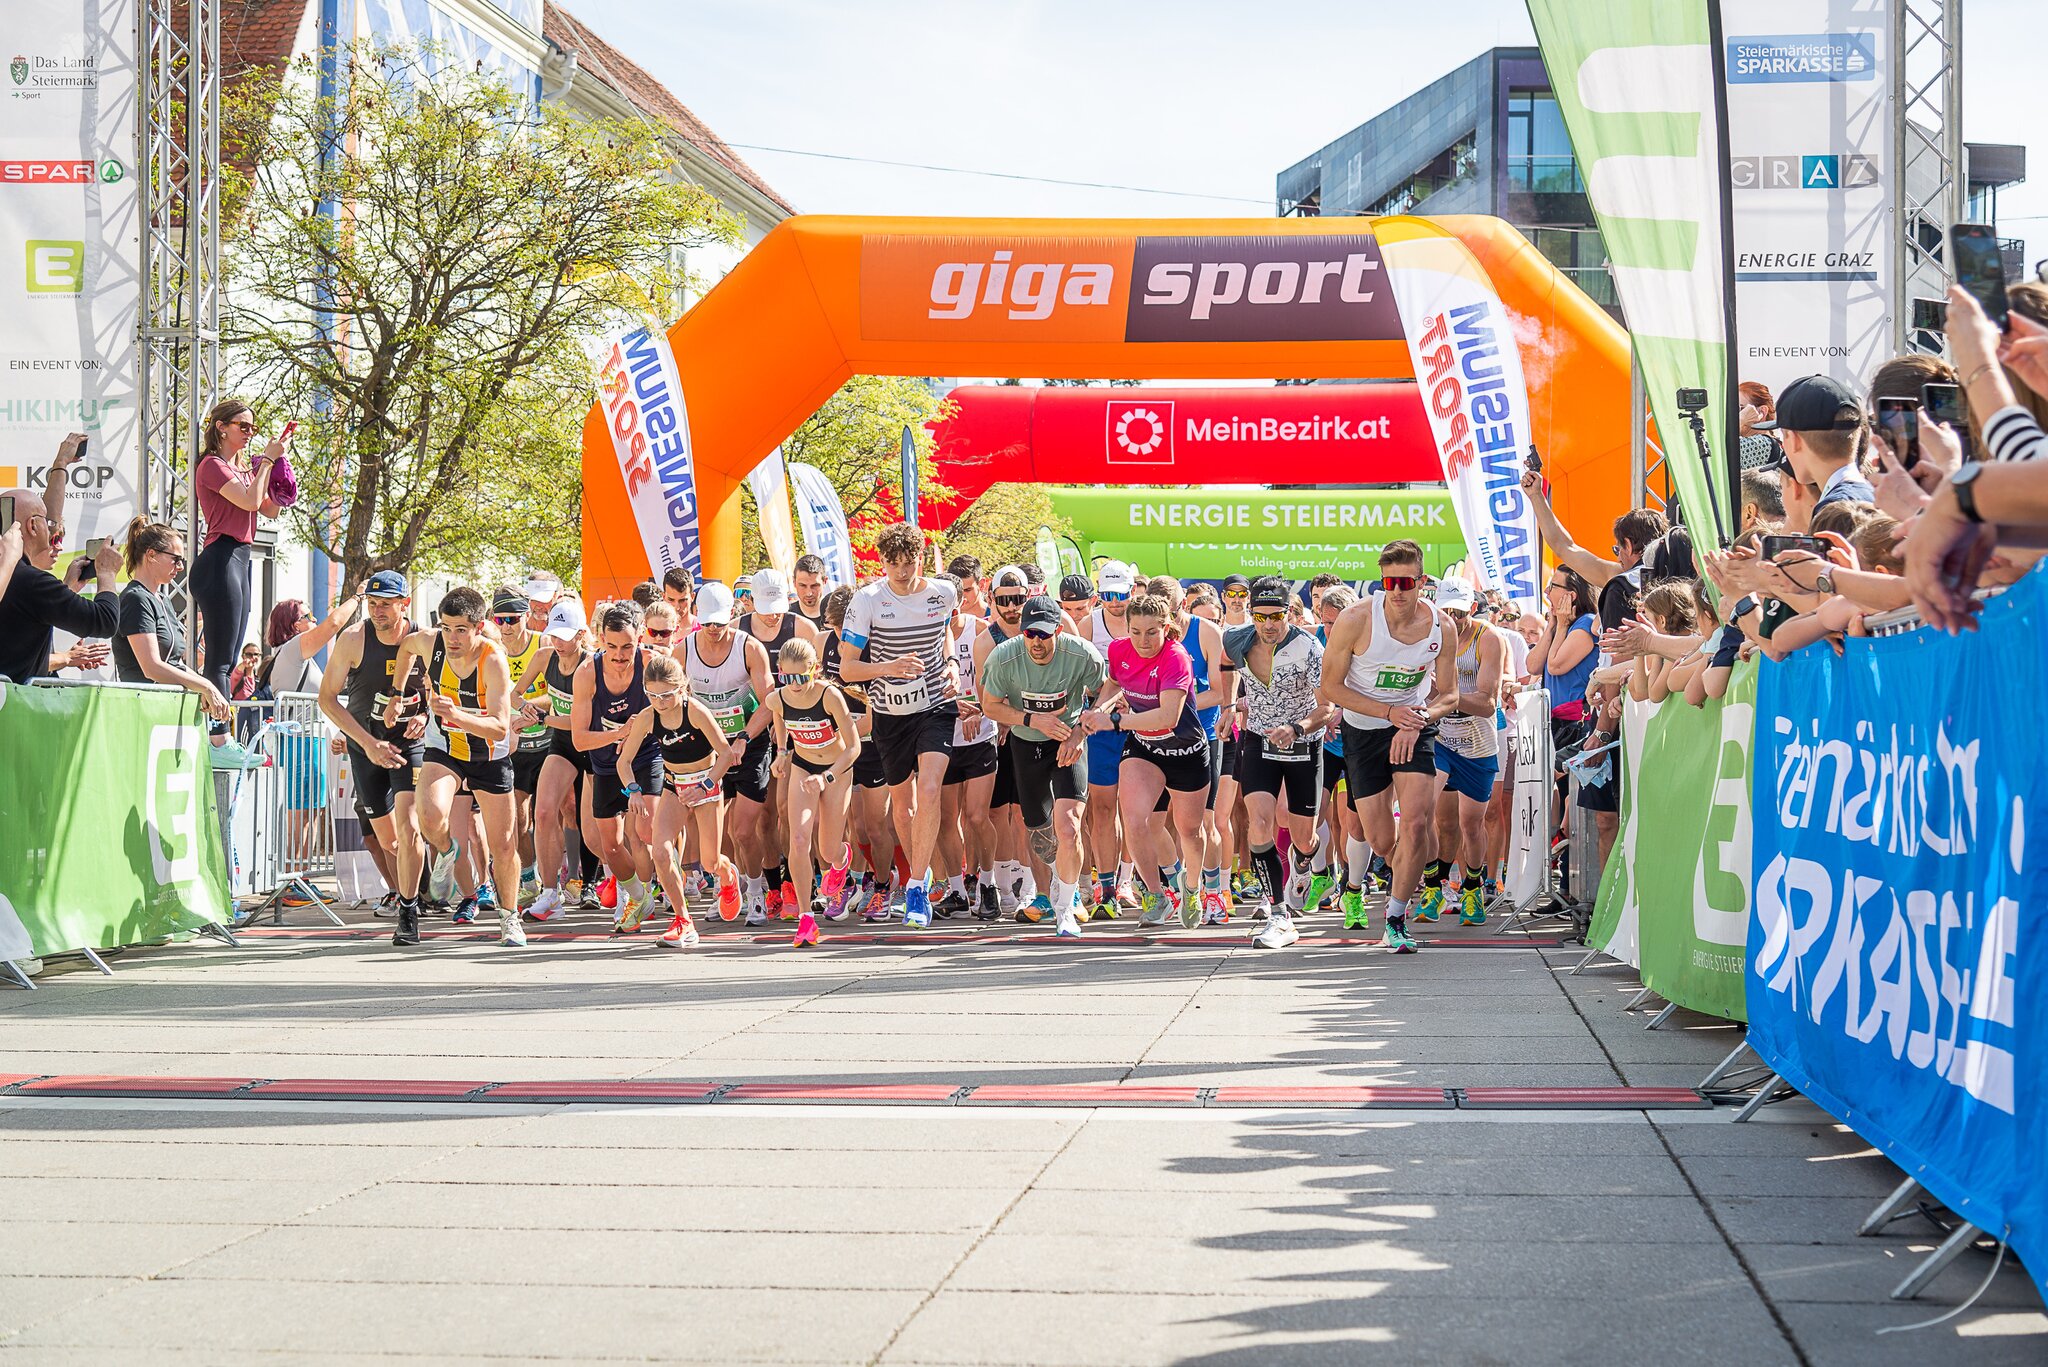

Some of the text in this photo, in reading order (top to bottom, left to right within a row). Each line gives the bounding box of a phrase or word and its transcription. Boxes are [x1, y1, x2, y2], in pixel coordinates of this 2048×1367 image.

[1737, 44, 1843, 58] Steiermärkische
[35, 56, 94, 68] Das Land
[1737, 56, 1843, 75] SPARKASSE
[32, 74, 95, 86] Steiermark
[21, 92, 41, 100] Sport
[4, 164, 93, 180] SPAR
[1731, 158, 1874, 187] GRAZ
[1739, 253, 1875, 268] ENERGIE GRAZ
[928, 250, 1379, 320] giga sport
[1750, 347, 1770, 357] EIN
[1774, 347, 1815, 357] EVENT
[10, 360, 30, 370] EIN
[33, 360, 71, 370] EVENT
[1186, 415, 1390, 444] MeinBezirk.at
[1129, 504, 1446, 528] ENERGIE STEIERMARK
[1240, 556, 1365, 571] holding-graz.at/apps
[1766, 599, 1782, 617] 2
[1390, 674, 1416, 684] 1342
[887, 687, 926, 705] 10171
[555, 698, 573, 710] 140
[1035, 701, 1055, 709] 931
[1715, 955, 1746, 974] STEIER
